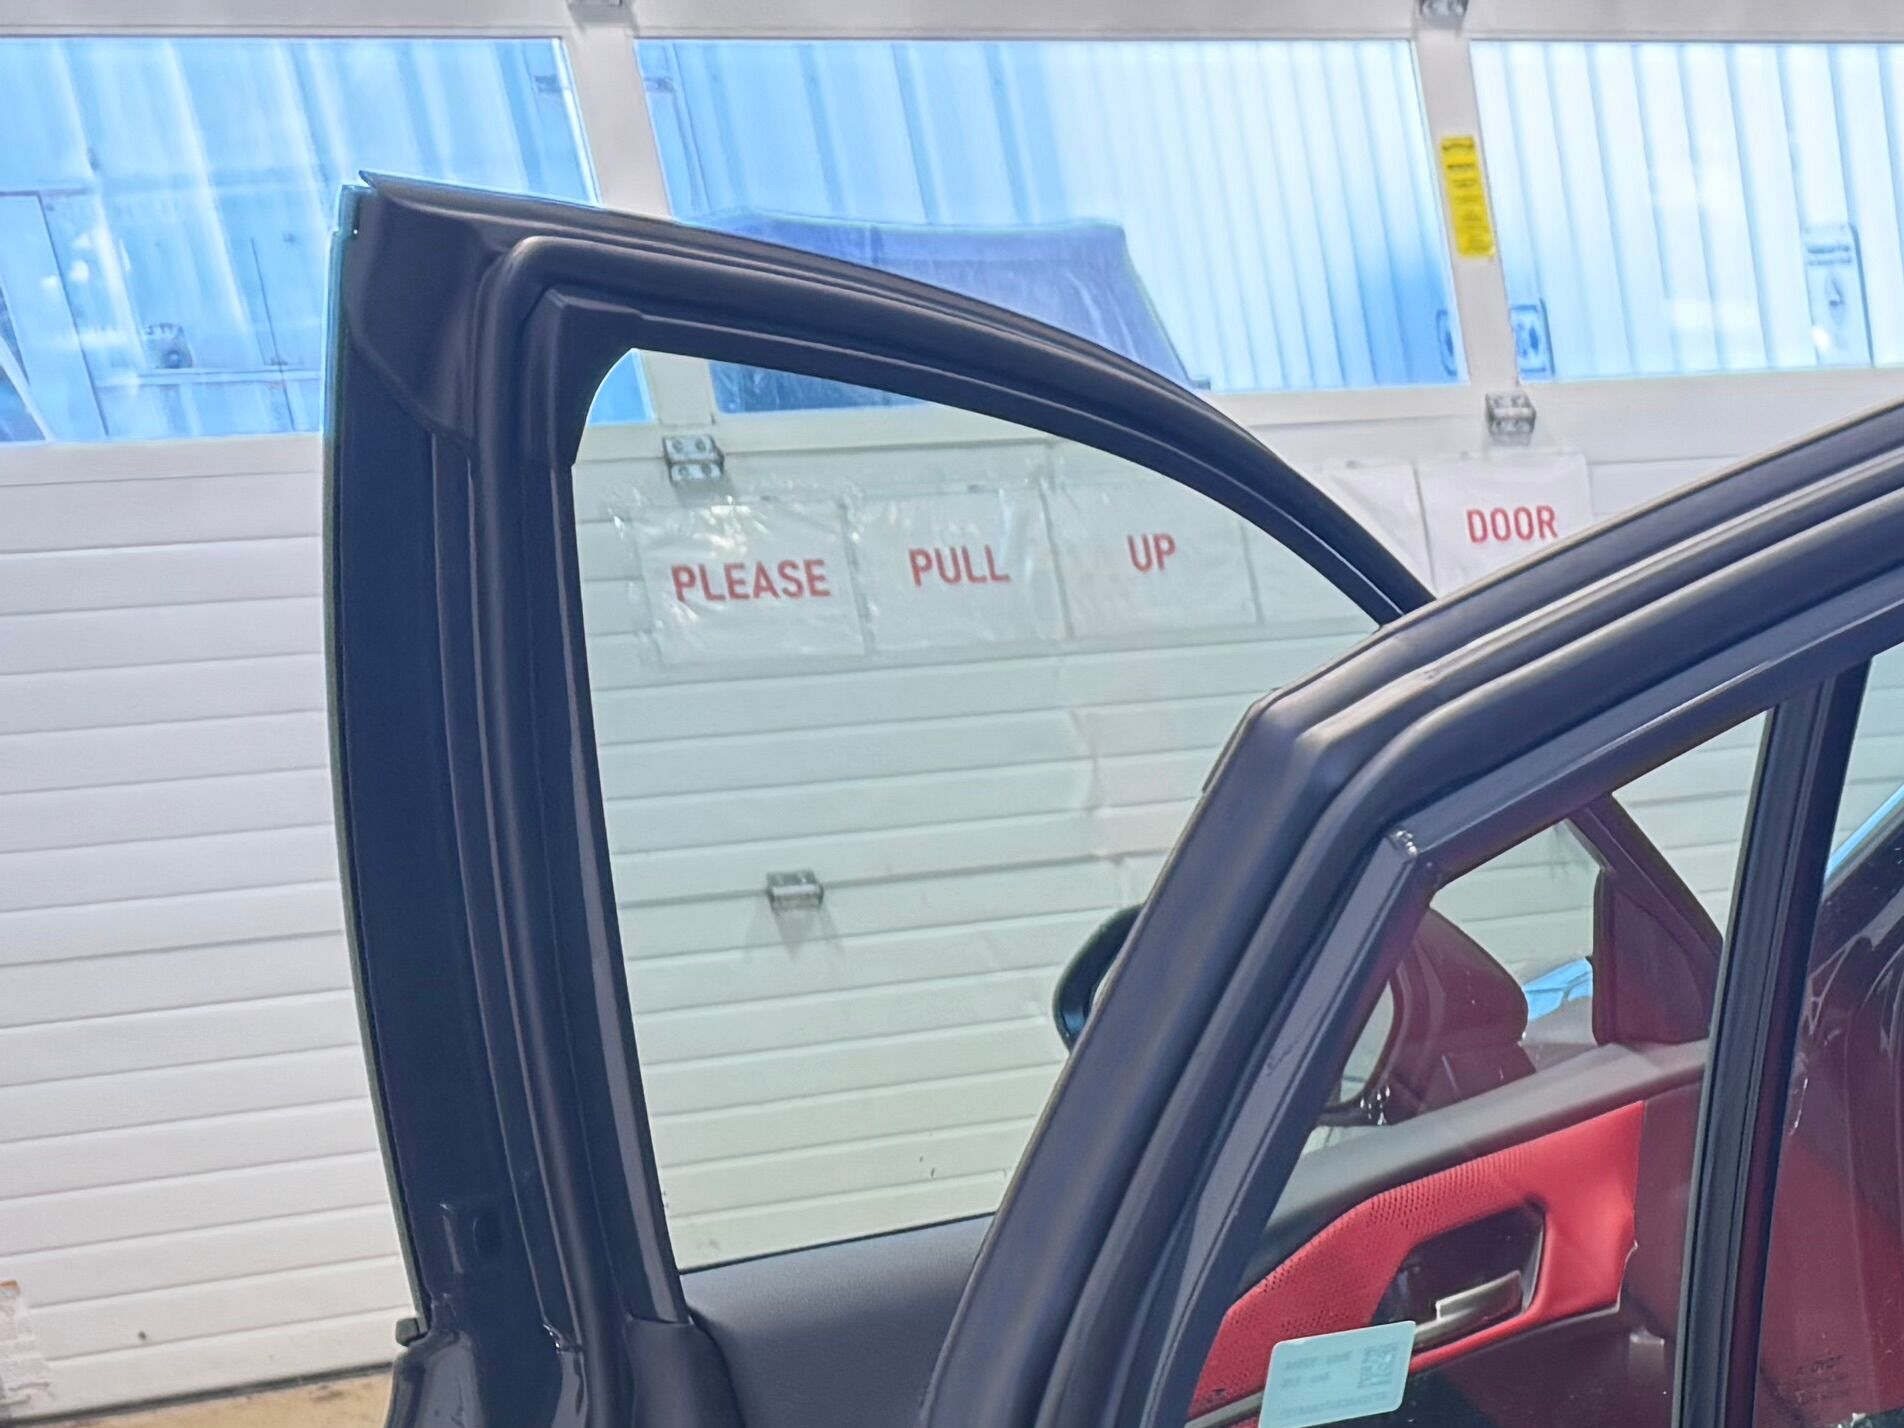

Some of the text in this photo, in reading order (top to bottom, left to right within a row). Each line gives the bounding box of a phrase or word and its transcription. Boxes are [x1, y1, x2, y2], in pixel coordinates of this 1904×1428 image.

[671, 504, 1560, 601] PLEASE PULL UP DOOR
